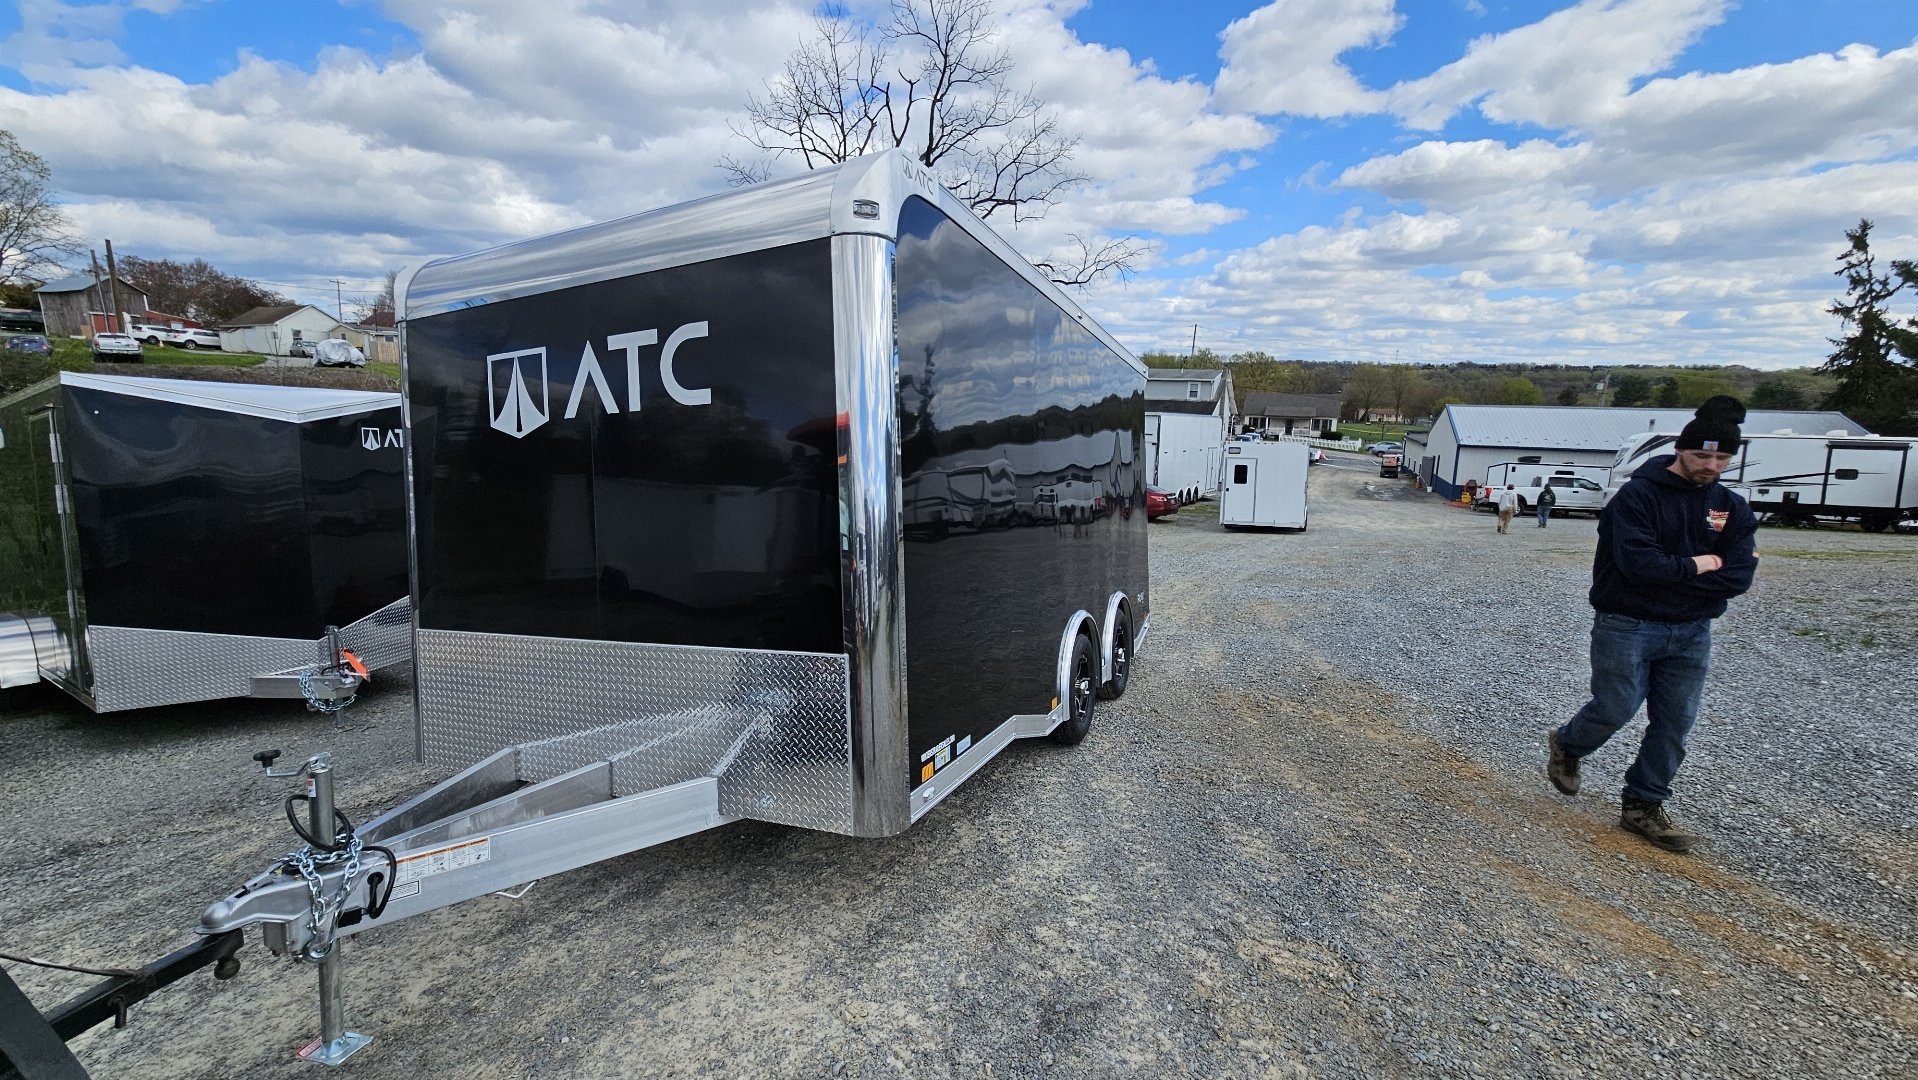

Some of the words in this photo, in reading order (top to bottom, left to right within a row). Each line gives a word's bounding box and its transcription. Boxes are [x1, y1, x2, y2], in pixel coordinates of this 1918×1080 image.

[914, 168, 933, 195] ATC
[564, 321, 711, 420] ATC
[383, 429, 404, 448] AT
